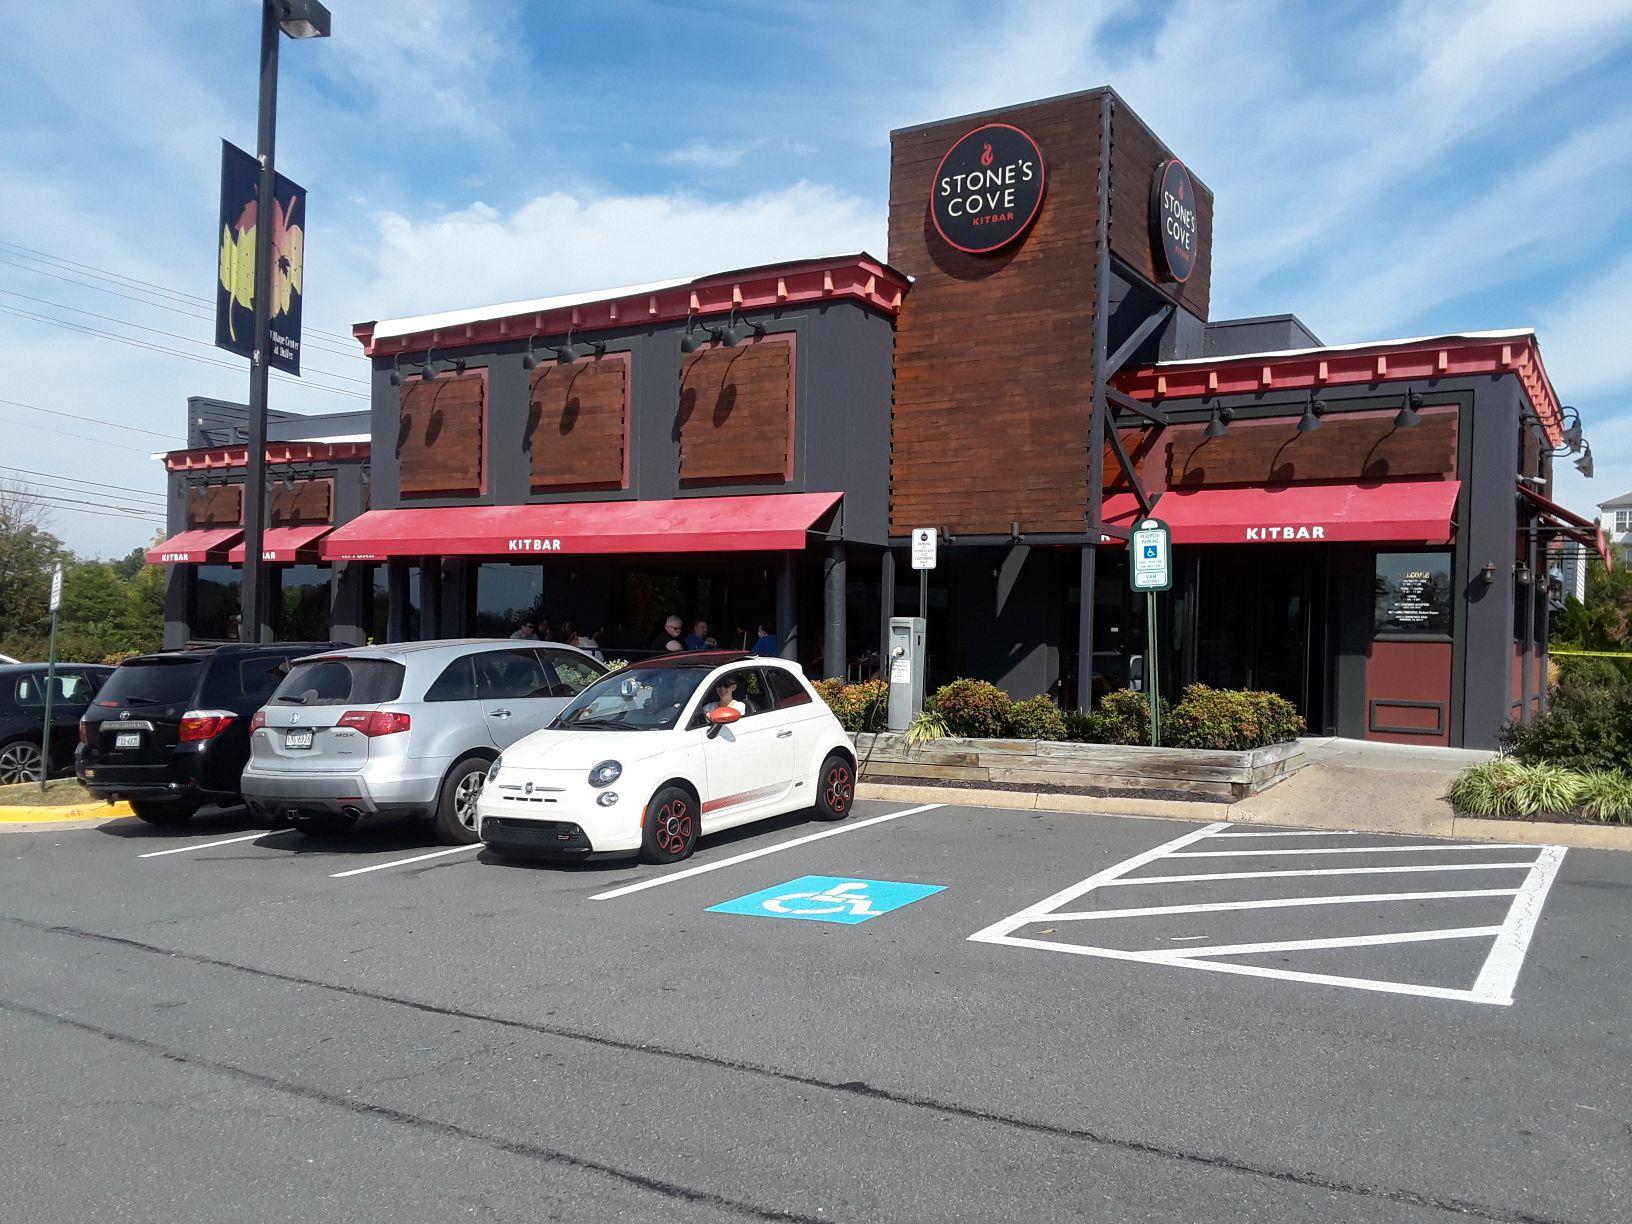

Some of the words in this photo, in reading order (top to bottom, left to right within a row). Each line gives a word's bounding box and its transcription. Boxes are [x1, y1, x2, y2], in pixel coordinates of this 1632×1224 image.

[941, 159, 1033, 196] STONE'S
[948, 188, 1015, 217] COVE
[1164, 190, 1195, 233] STONE'S
[972, 212, 1014, 226] KITBAR
[1166, 216, 1190, 250] COVE
[1246, 526, 1325, 540] KITBAR
[508, 539, 561, 551] KITBAR
[161, 553, 189, 562] KITBAR
